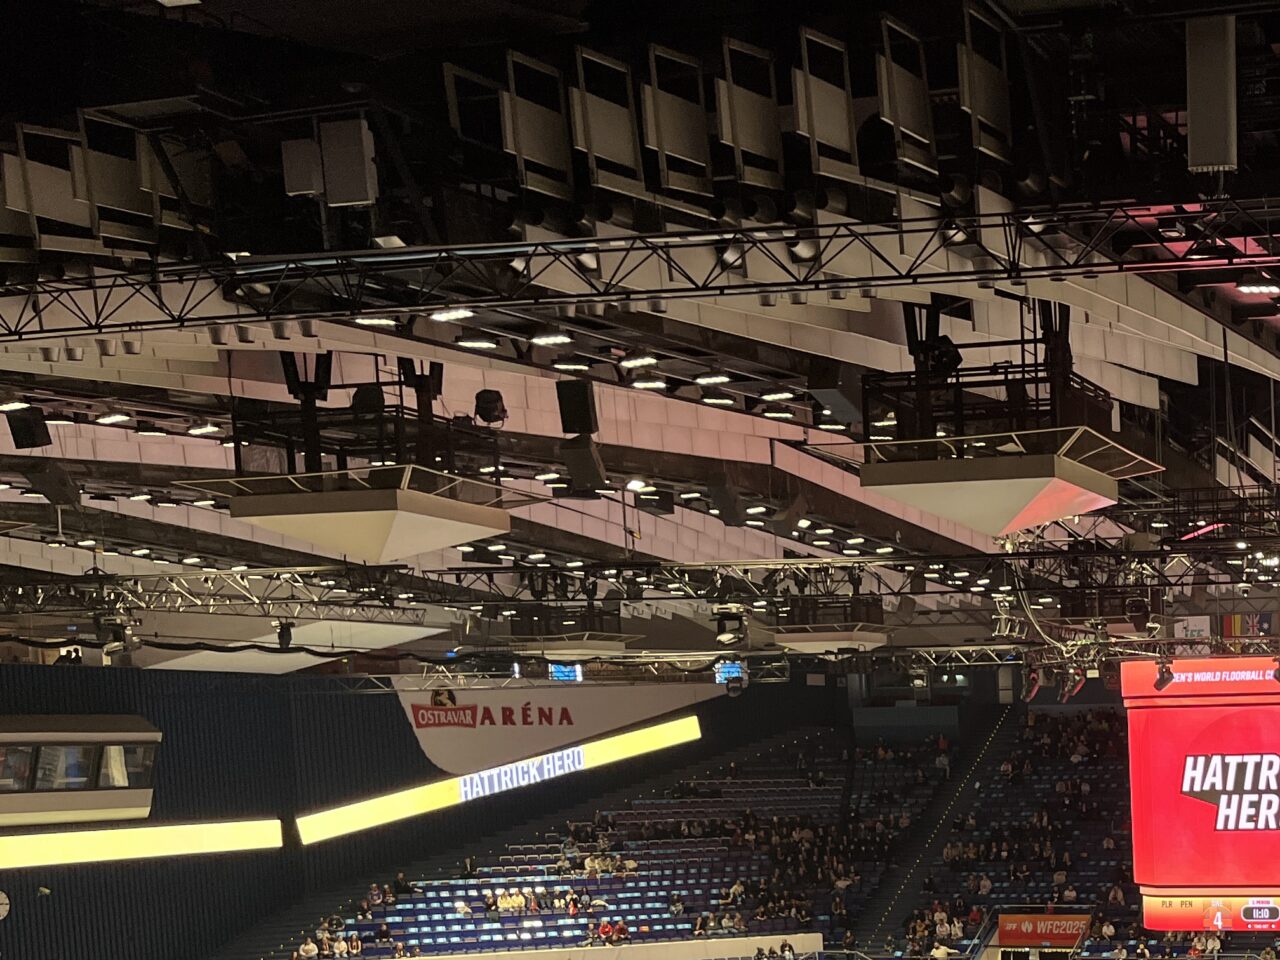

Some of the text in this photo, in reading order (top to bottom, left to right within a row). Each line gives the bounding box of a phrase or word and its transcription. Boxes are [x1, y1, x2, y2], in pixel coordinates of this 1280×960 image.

[1194, 669, 1220, 681] WORLD
[1221, 668, 1264, 681] FLOORBALL
[418, 701, 574, 726] OSTRAVAR ARÉNA
[460, 746, 584, 801] HATTRICK HERO
[1162, 900, 1193, 909] PLR PEN
[1036, 920, 1086, 934] WFC2025
[1213, 911, 1223, 929] 4
